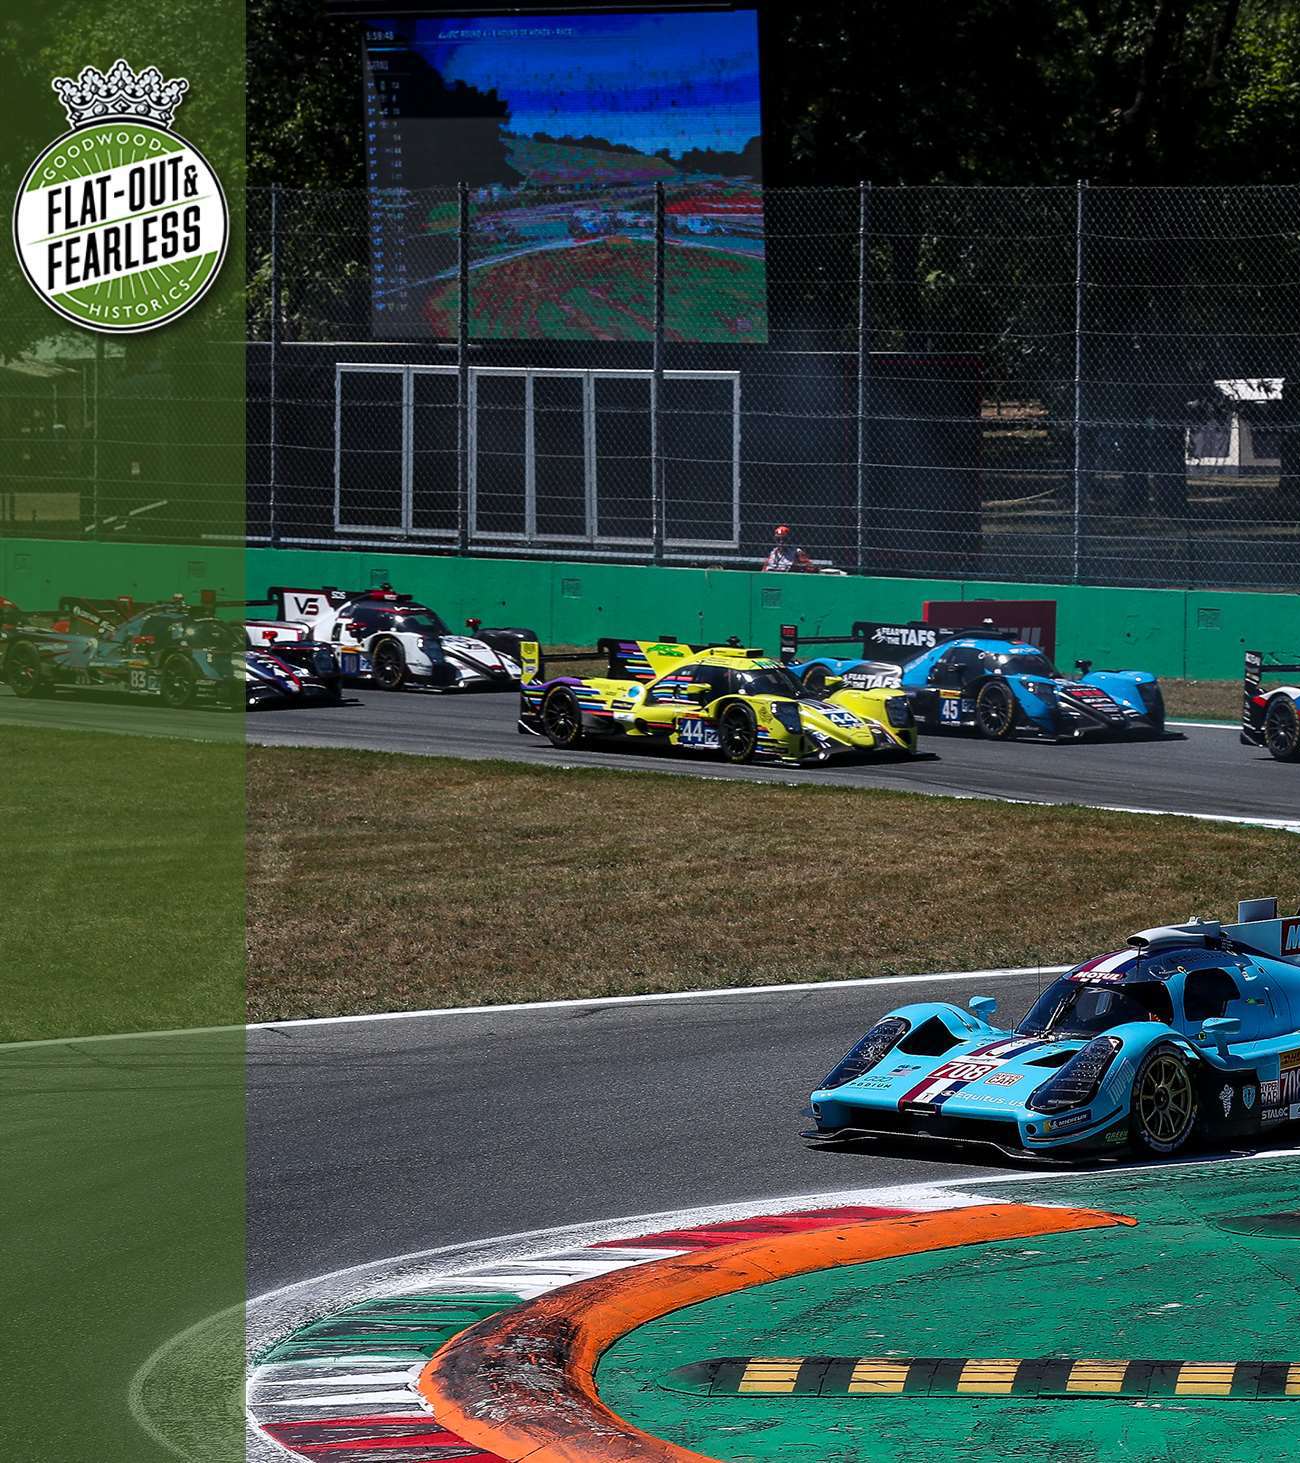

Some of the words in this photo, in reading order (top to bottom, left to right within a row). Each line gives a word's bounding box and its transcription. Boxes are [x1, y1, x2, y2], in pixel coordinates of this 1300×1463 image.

[881, 627, 900, 636] FEAR
[900, 629, 936, 648] TAFS
[887, 636, 900, 645] THE
[130, 671, 146, 688] 83
[849, 673, 867, 682] FEAR
[865, 675, 903, 690] TAFS
[942, 700, 959, 720] 45
[829, 713, 858, 724] 44
[682, 720, 703, 742] 44
[1073, 971, 1121, 981] MOTUL
[942, 1062, 990, 1080] 708
[987, 1077, 1015, 1087] CAR
[1260, 1081, 1278, 1095] HYPER
[1260, 1091, 1279, 1106] CAR
[1058, 1113, 1089, 1127] MICHELIN
[1261, 1106, 1288, 1120] STALOC
